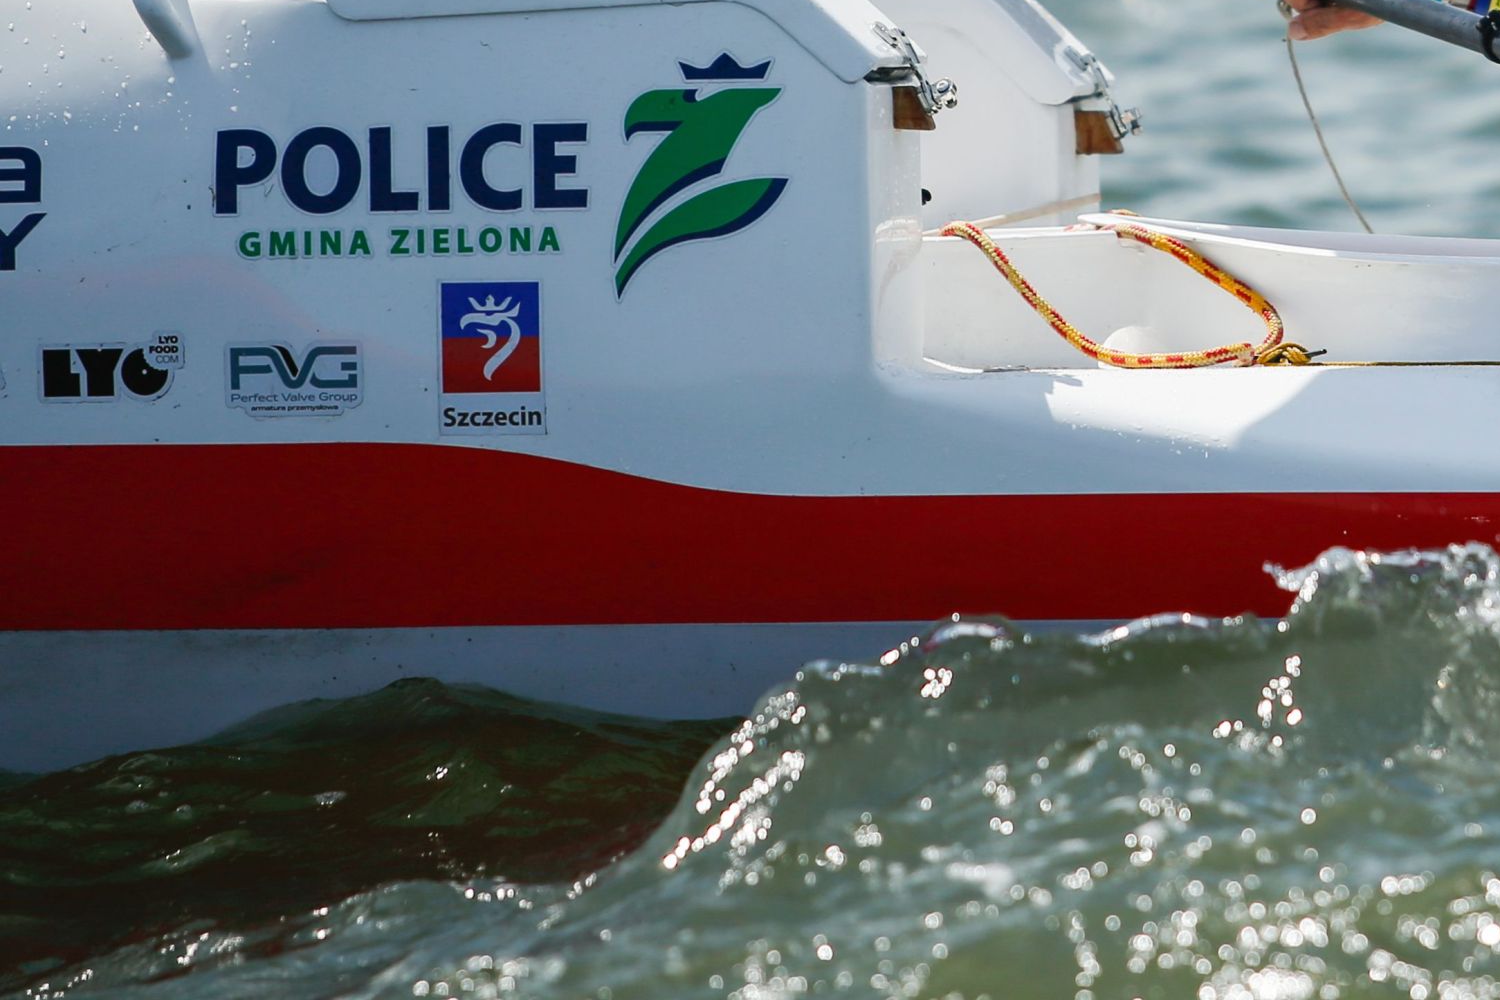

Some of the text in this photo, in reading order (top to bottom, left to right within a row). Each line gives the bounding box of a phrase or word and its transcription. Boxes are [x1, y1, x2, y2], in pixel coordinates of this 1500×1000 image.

[215, 122, 589, 215] POLICE
[238, 226, 561, 258] GMINA ZIELONA
[149, 345, 179, 354] FOOD
[231, 392, 358, 403] Perfect Valve Group
[443, 405, 542, 427] Szczecin
